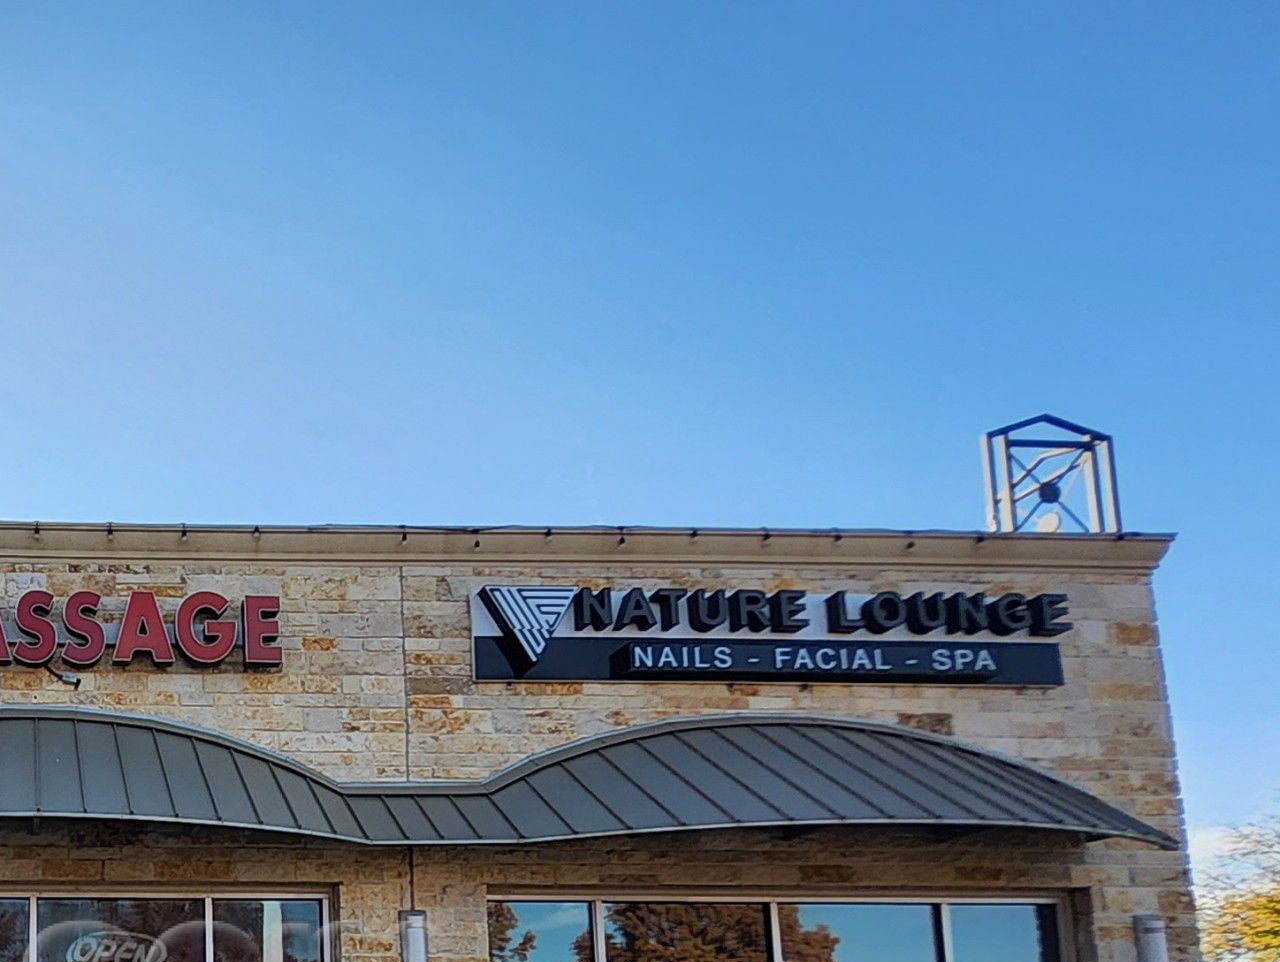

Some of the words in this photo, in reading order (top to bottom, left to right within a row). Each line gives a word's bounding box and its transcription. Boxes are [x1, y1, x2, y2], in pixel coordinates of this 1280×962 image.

[574, 587, 810, 633] NATURE
[826, 590, 1074, 637] LOUNGE
[633, 645, 733, 669] NAILS
[774, 647, 893, 670] FACIAL
[931, 648, 998, 671] SPA
